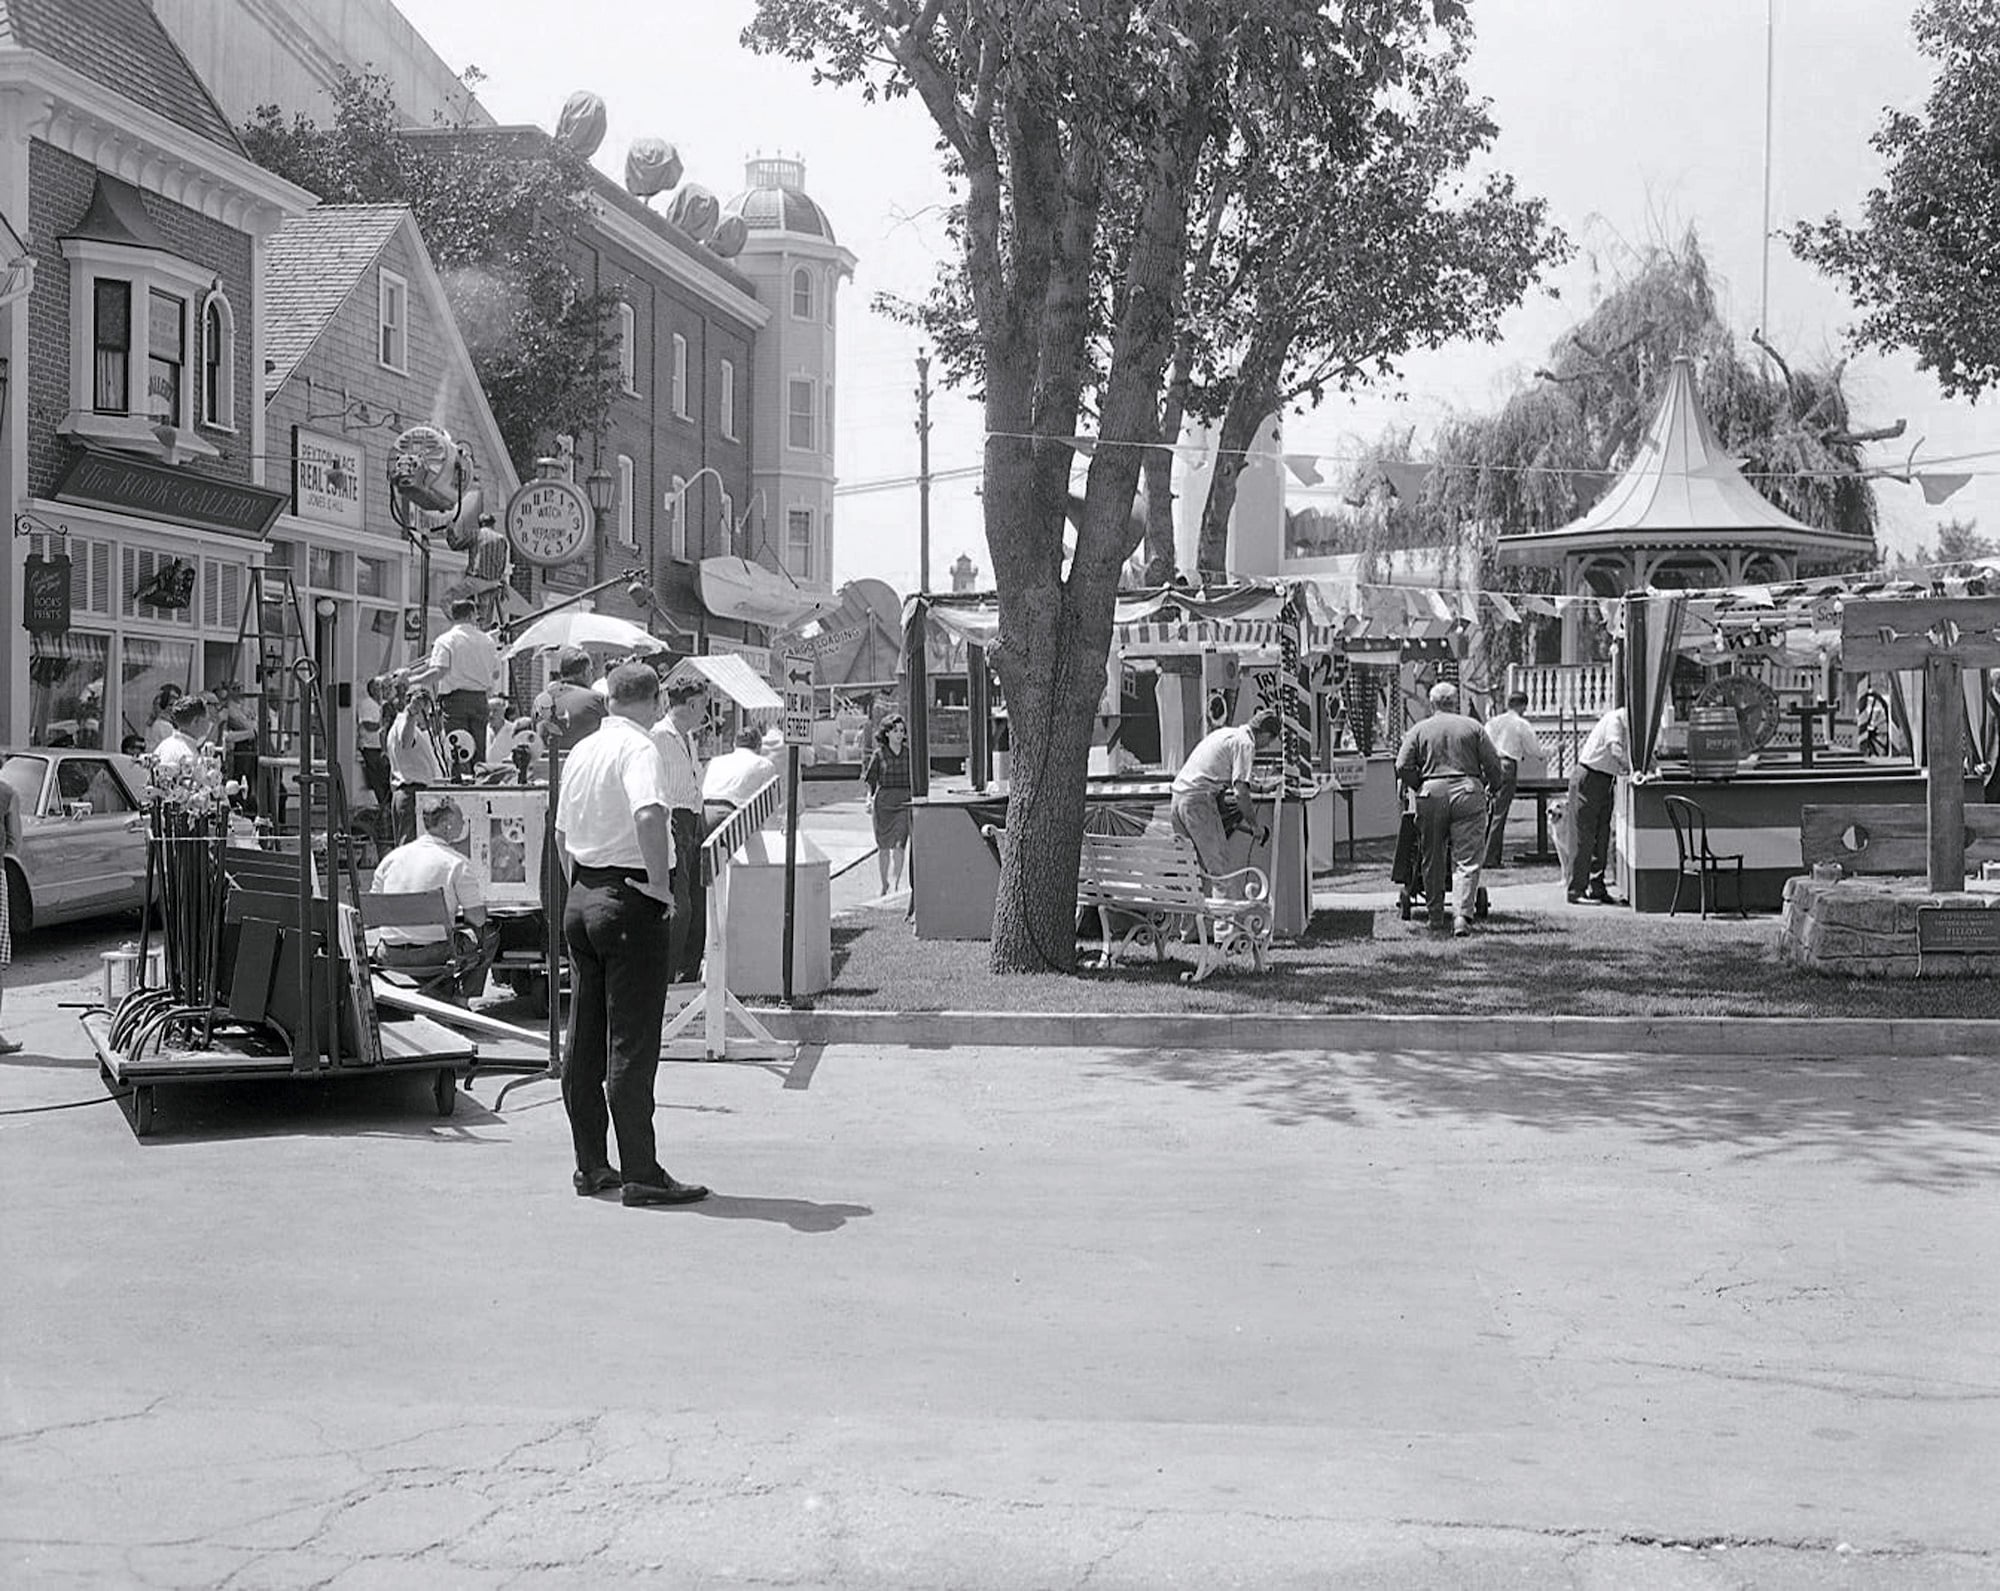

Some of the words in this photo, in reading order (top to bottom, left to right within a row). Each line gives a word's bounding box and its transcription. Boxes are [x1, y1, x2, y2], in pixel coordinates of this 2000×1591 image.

[300, 461, 324, 493] REAL
[80, 463, 117, 490] The
[115, 470, 178, 506] BOOK
[178, 486, 262, 522] GALLERY
[533, 493, 540, 506] 11
[543, 488, 554, 503] 12
[559, 493, 564, 506] 1
[521, 503, 532, 515] 10
[567, 501, 575, 515] 2
[516, 517, 523, 531] 9
[572, 516, 580, 530] 3
[521, 531, 528, 543] 8
[565, 532, 573, 545] 4
[532, 540, 540, 553] 7
[544, 543, 552, 556] 6
[33, 597, 62, 607] BOOKS
[780, 642, 815, 659] CARGO
[816, 628, 860, 649] LOADING
[1252, 671, 1277, 690] TRY
[786, 717, 811, 737] STREET
